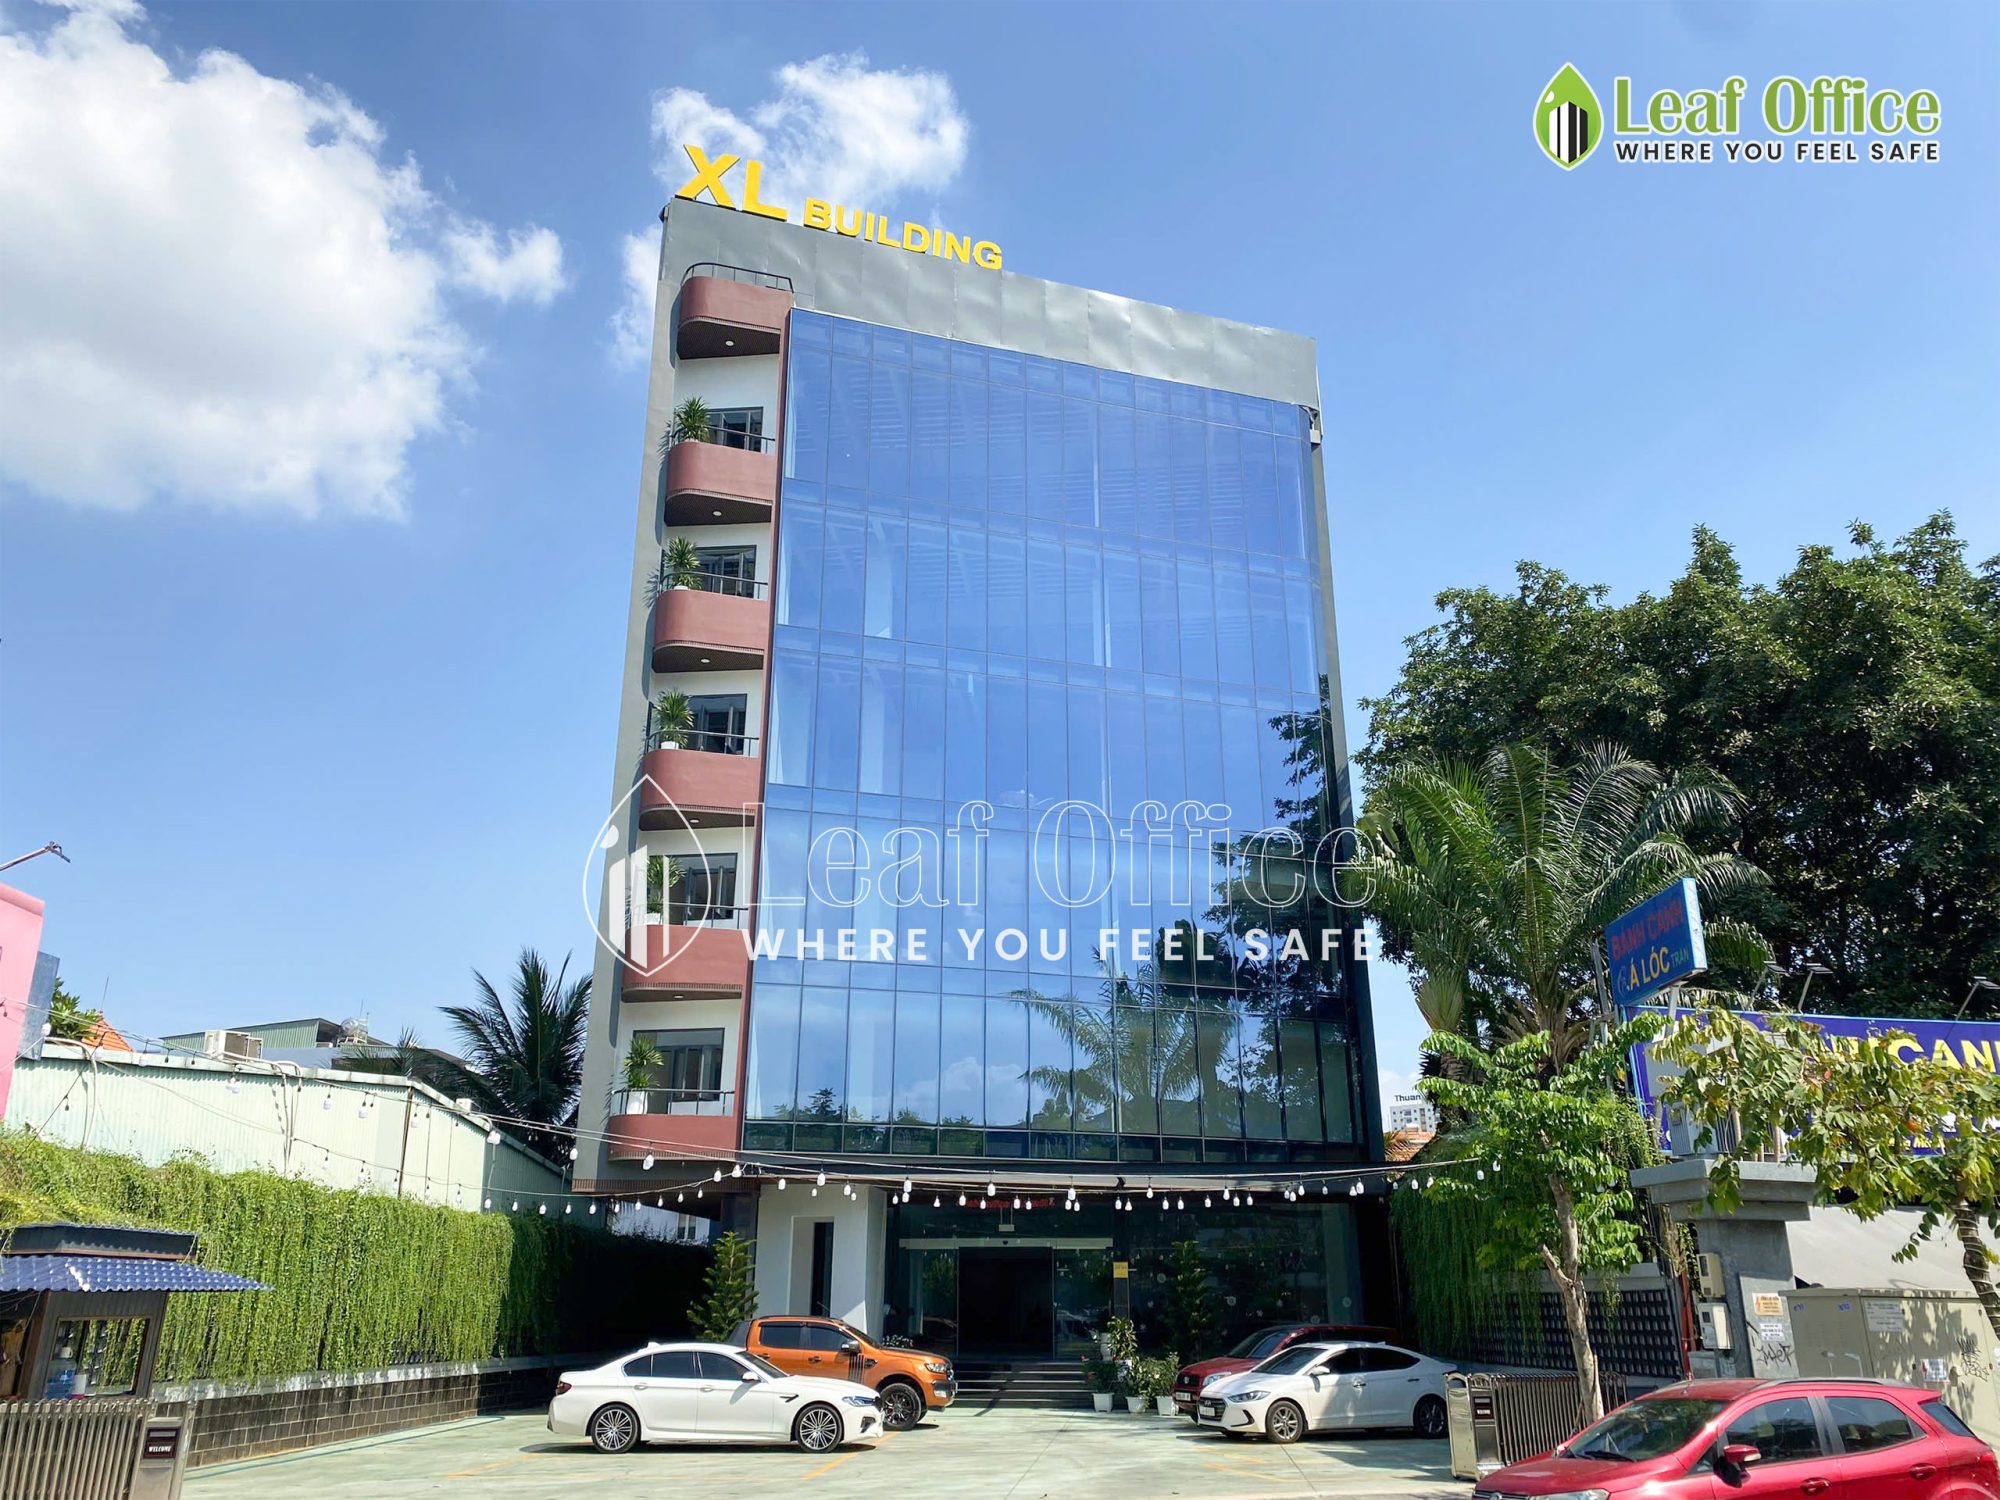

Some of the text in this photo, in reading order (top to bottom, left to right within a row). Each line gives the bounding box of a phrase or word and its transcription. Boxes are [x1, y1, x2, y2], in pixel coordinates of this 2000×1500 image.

[675, 144, 1003, 270] XL BUILDING
[1887, 1038, 2000, 1073] CAN
[149, 1445, 171, 1453] WELCOME
